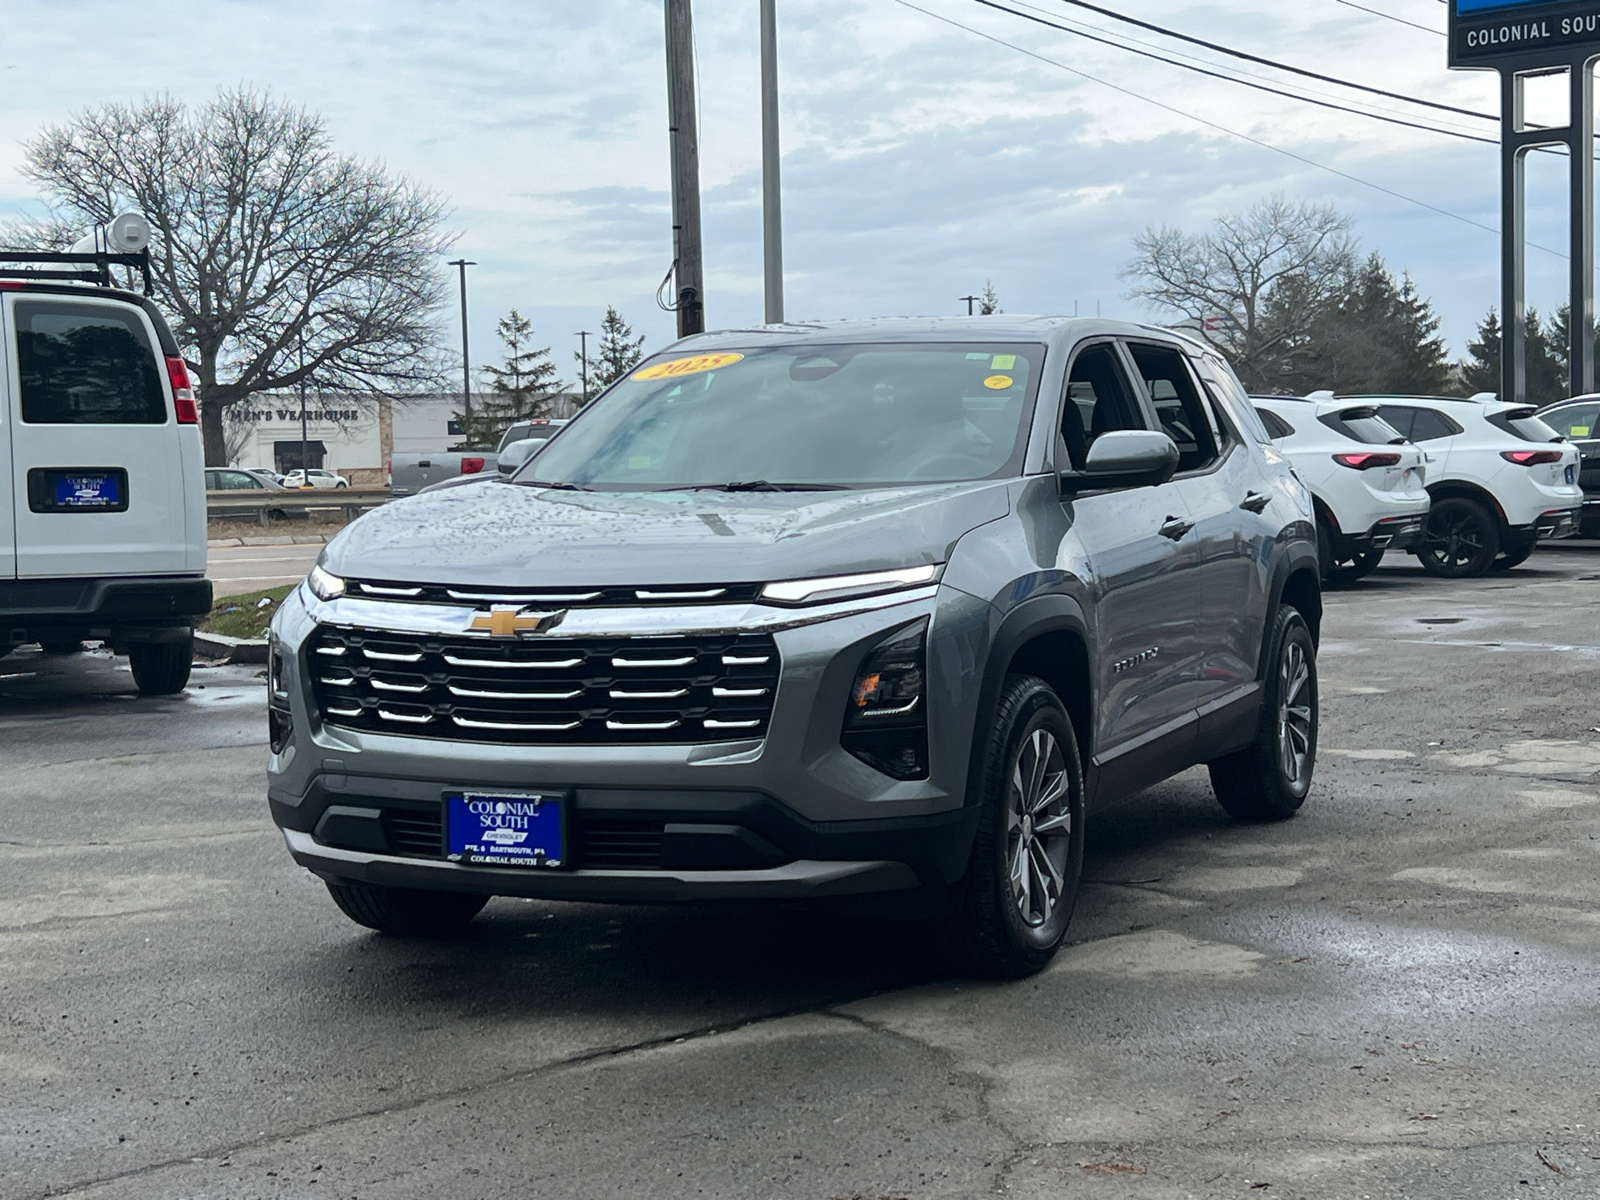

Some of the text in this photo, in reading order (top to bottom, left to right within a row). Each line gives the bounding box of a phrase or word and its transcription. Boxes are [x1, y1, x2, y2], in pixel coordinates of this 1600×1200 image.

[1467, 21, 1550, 47] COLONIAL
[648, 354, 731, 378] 2025
[230, 409, 273, 421] MEN'S
[469, 801, 539, 816] COLONIAL
[480, 815, 528, 828] SOUTH
[486, 832, 524, 841] CHEVROLET
[470, 855, 537, 866] COLONIAL SOUTH
